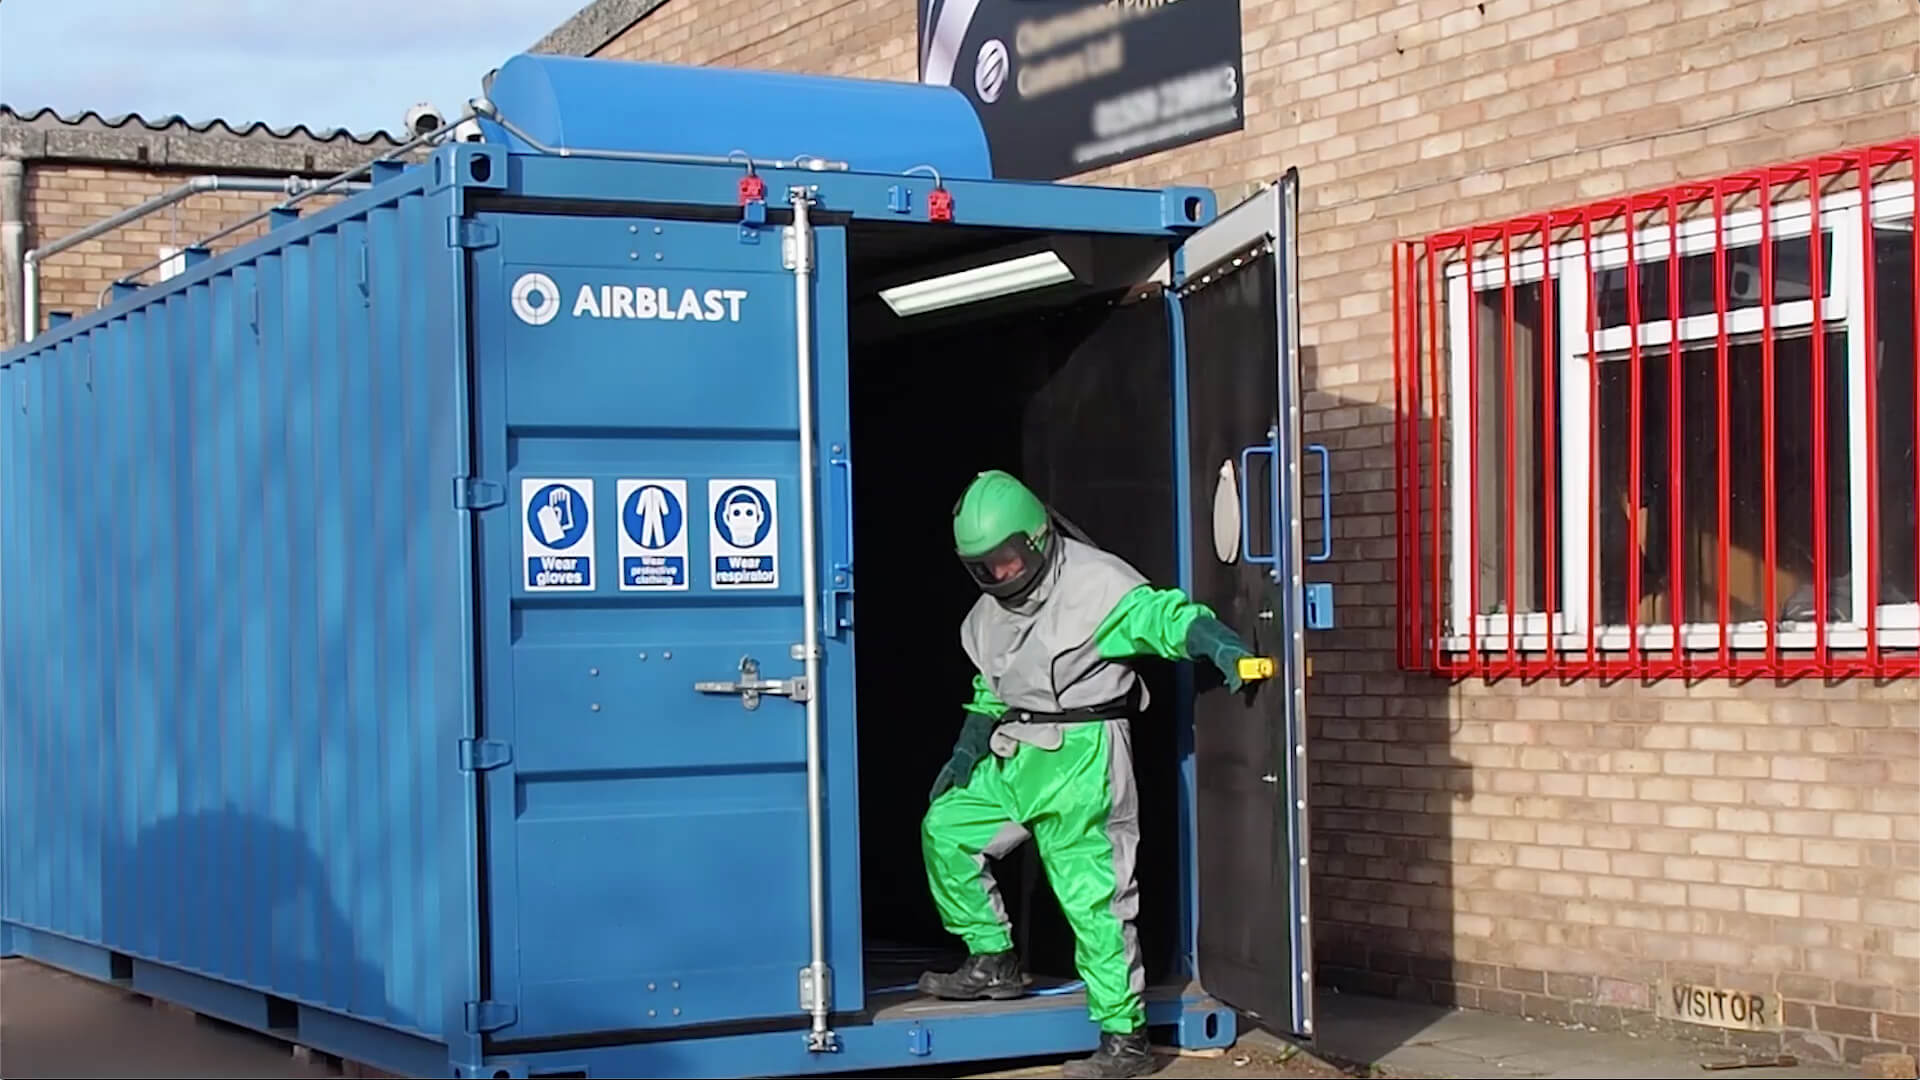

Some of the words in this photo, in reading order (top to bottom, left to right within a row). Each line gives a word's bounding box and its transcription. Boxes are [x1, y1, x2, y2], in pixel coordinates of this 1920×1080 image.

[572, 284, 748, 322] AIRBLAST
[540, 556, 578, 571] Wear
[727, 556, 761, 569] Wear
[536, 570, 583, 586] gloves
[716, 569, 775, 584] respirator
[1671, 985, 1765, 1024] VISITOR
